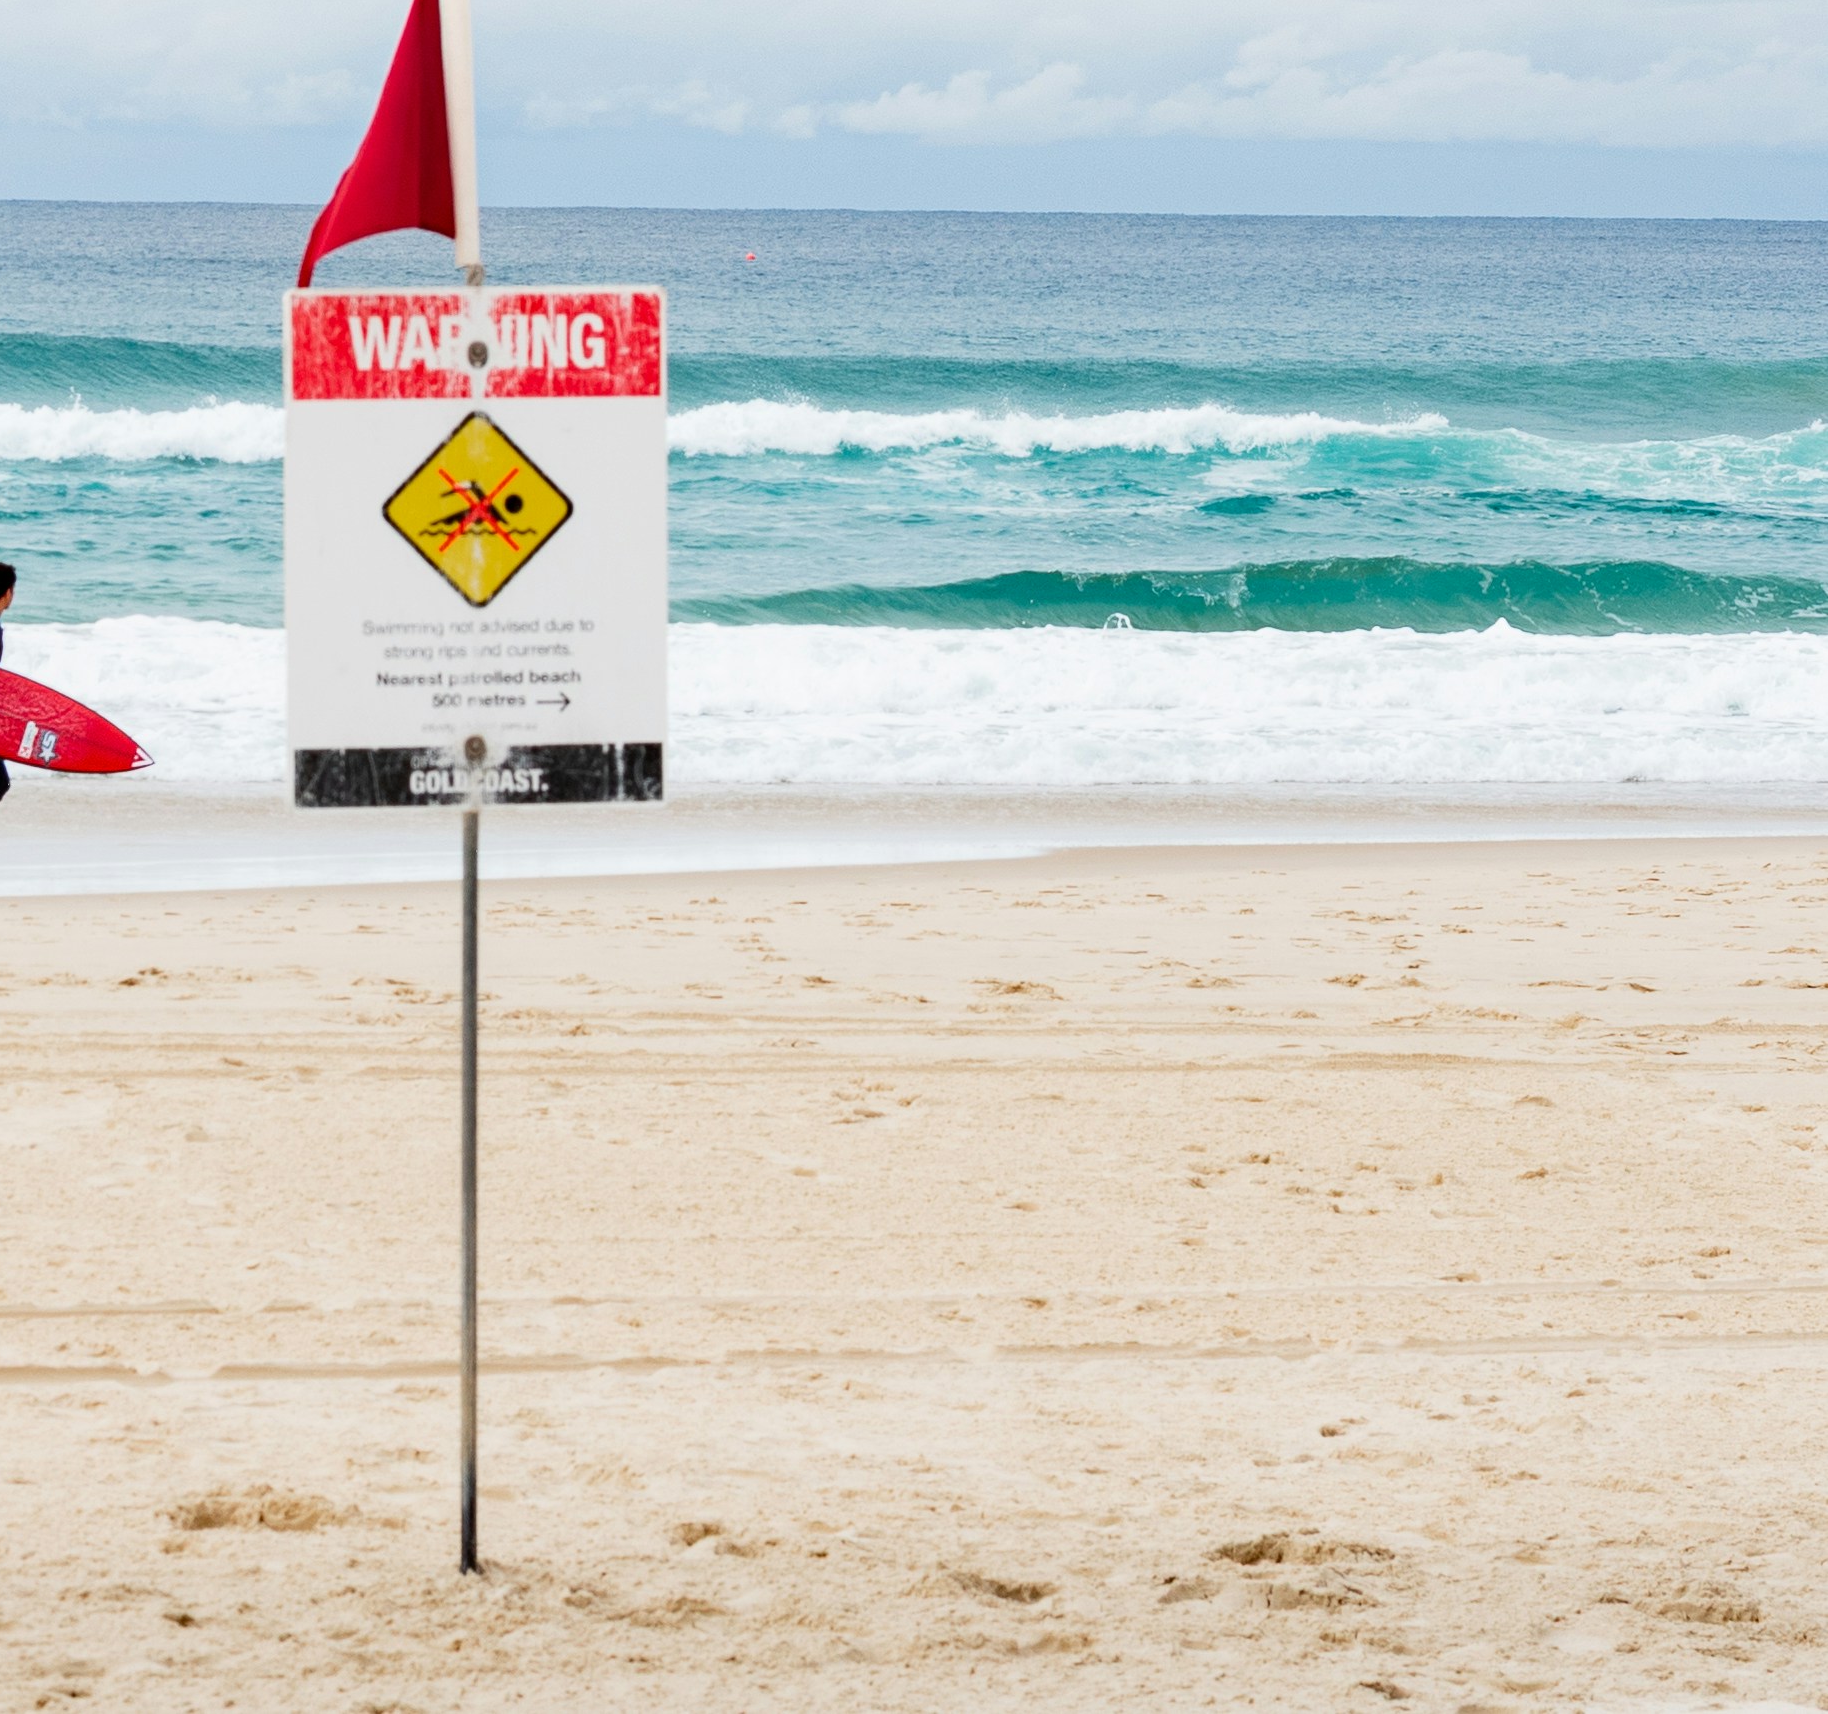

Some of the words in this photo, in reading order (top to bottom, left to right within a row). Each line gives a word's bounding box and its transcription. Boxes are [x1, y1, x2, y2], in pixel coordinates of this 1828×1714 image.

[362, 619, 444, 637] Swimming
[449, 620, 473, 634] not
[480, 618, 540, 634] advised
[544, 618, 574, 633] due
[579, 619, 595, 633] to
[383, 645, 434, 660] strong
[438, 644, 467, 659] rips
[376, 672, 443, 686] Nearest
[529, 669, 582, 684] beach
[431, 693, 462, 708] 500
[409, 768, 549, 795] GOLDOAST.
